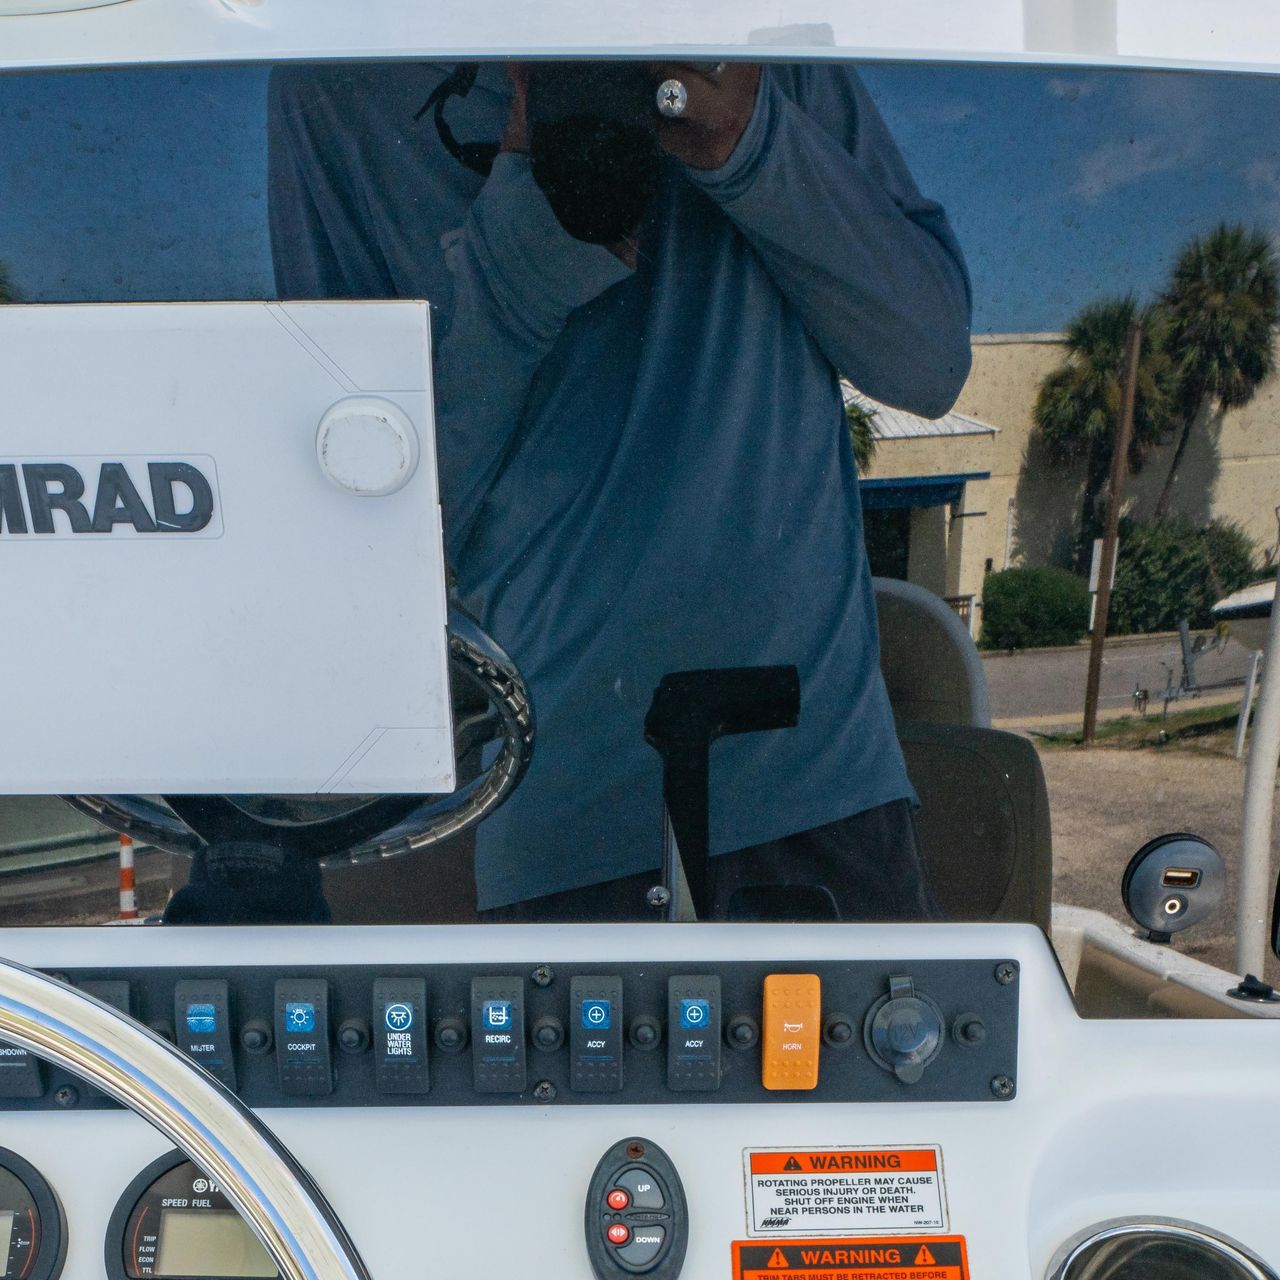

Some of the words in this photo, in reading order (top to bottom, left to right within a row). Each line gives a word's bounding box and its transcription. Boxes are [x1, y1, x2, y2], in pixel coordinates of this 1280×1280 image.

[387, 1033, 411, 1041] UNDER
[485, 1035, 511, 1043] RECIRC
[287, 1043, 316, 1051] COCKPIT
[587, 1040, 605, 1048] ACCY
[685, 1040, 703, 1048] ACCY
[782, 1043, 802, 1051] HORN
[809, 1154, 901, 1170] WARNING
[757, 1178, 807, 1188] ROTATING
[810, 1177, 871, 1187] PROPELLER
[873, 1177, 895, 1186] MAY
[897, 1176, 933, 1185] CAUSE
[637, 1184, 651, 1192] UP
[775, 1188, 821, 1197] SERIOUS
[823, 1187, 859, 1196] INJURY
[861, 1187, 877, 1195] OR
[879, 1186, 916, 1195] DEATH.
[161, 1198, 188, 1207] SPEED
[192, 1199, 212, 1207] FUEL
[784, 1197, 812, 1206] SHUT
[815, 1196, 835, 1205] OFF
[837, 1196, 876, 1205] ENGINE
[877, 1195, 909, 1204] WHEN
[770, 1206, 799, 1215] NEAR
[801, 1206, 851, 1215] PERSONS
[853, 1205, 863, 1214] IN
[865, 1205, 886, 1214] THE
[888, 1204, 924, 1213] WATER
[800, 1249, 901, 1265] WARNING
[808, 1273, 834, 1280] MUST
[836, 1273, 850, 1280] BE
[851, 1272, 907, 1280] RETRACTED
[909, 1271, 947, 1280] BEFORE
